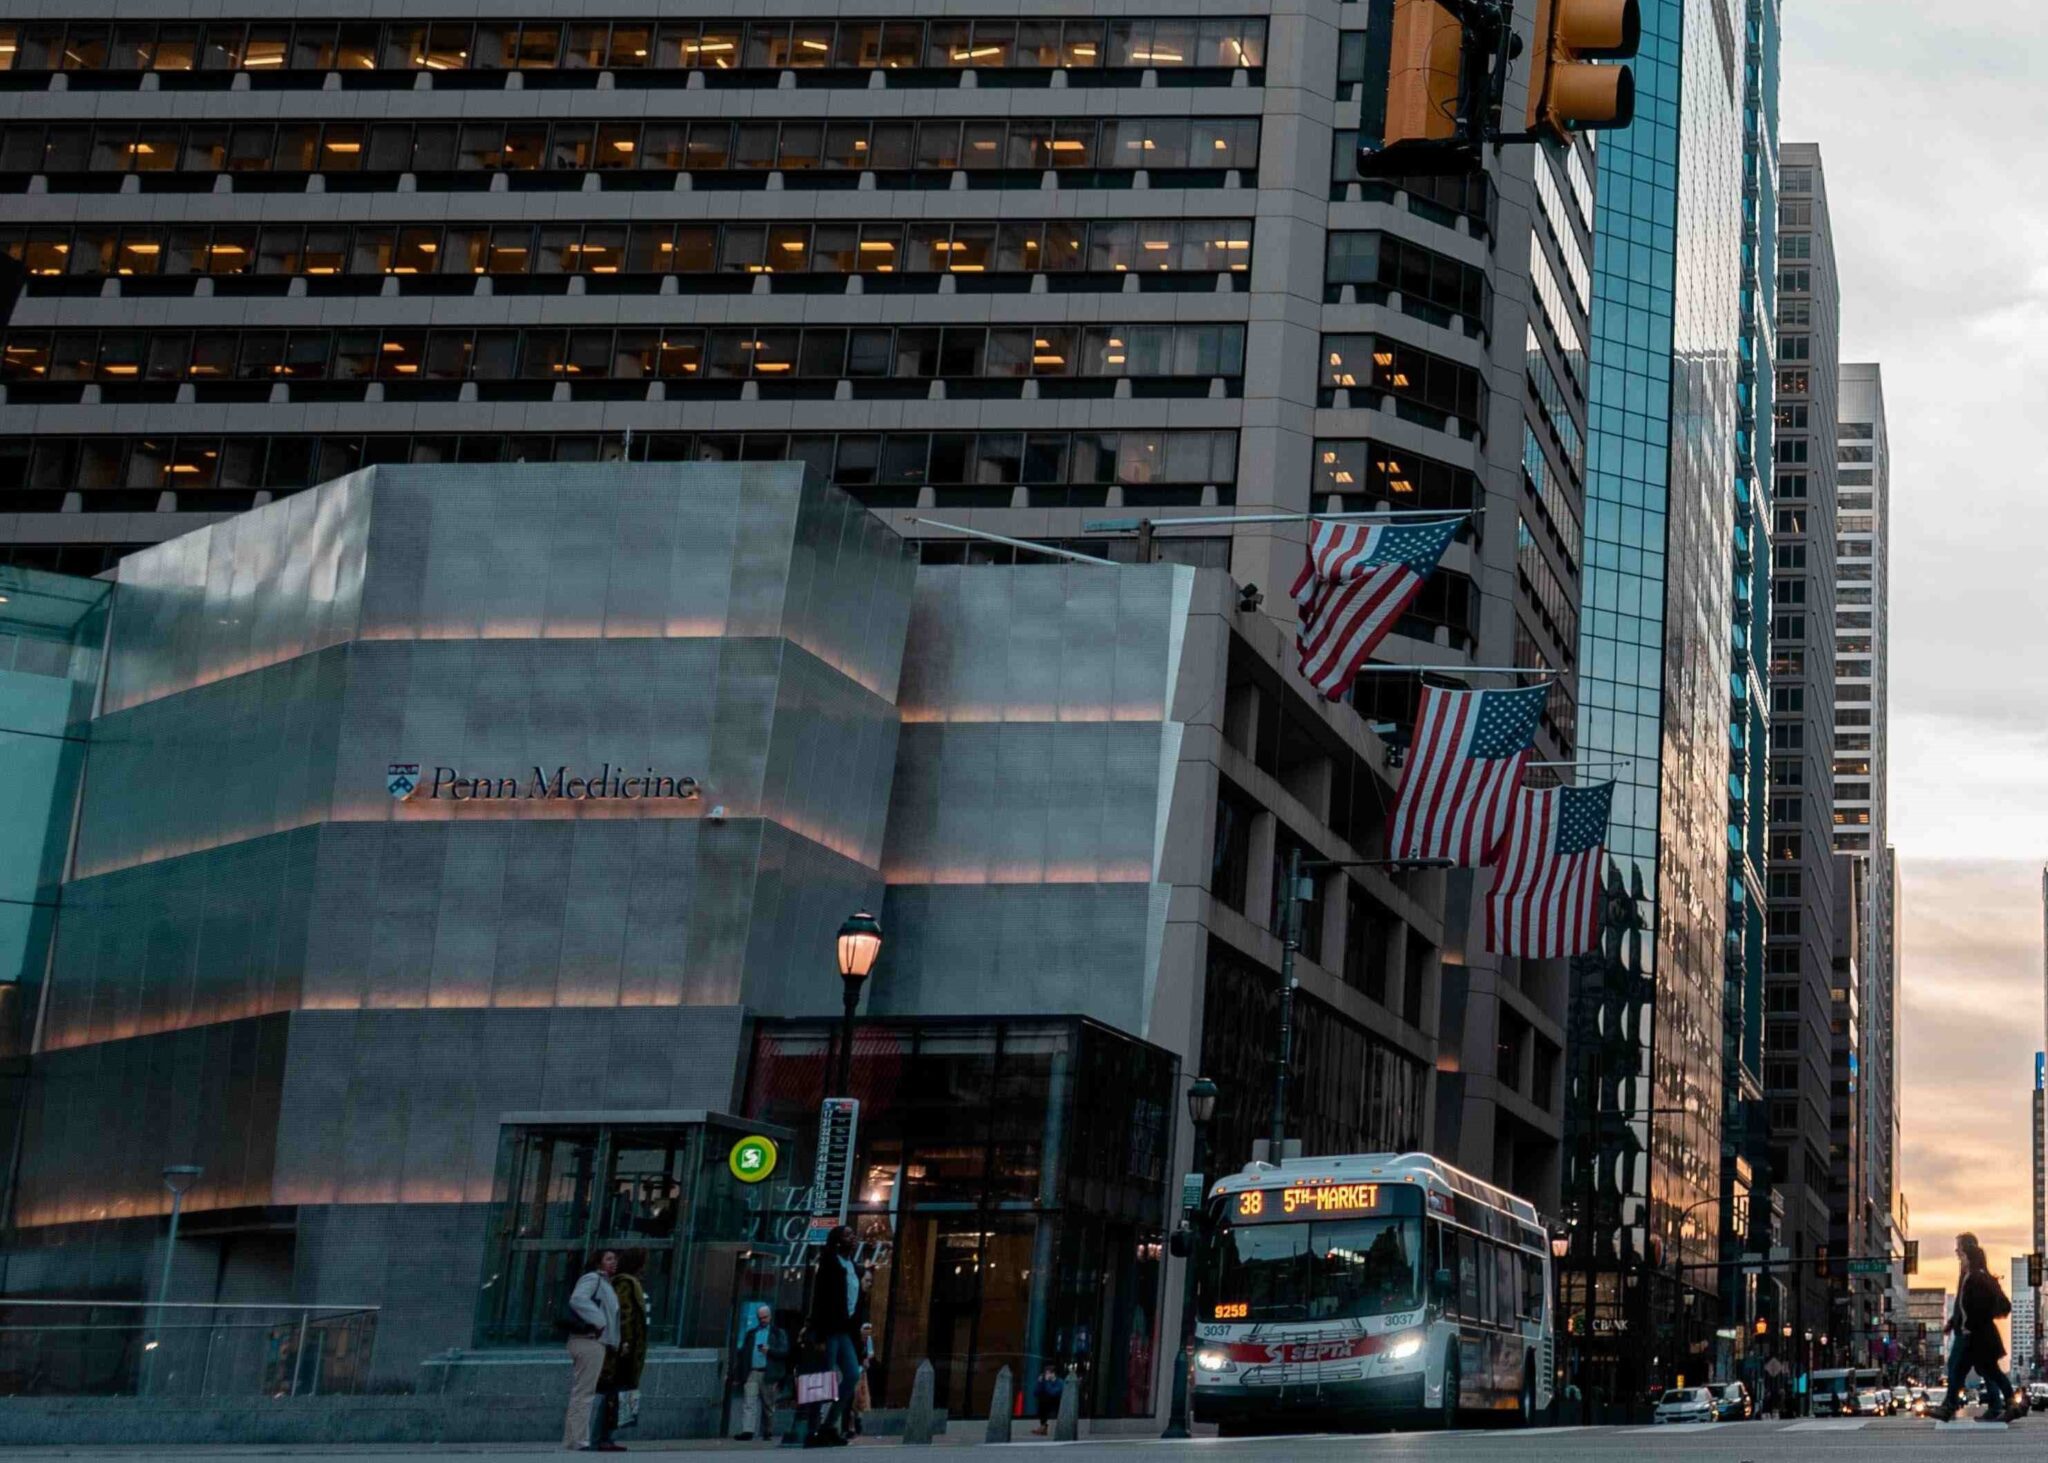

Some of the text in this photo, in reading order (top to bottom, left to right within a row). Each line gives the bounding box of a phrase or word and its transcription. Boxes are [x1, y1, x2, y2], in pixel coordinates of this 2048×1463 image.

[431, 763, 699, 800] Penn Medicine
[1239, 1185, 1379, 1215] 38 5TH-MARKET
[1214, 1304, 1248, 1319] 9258
[1384, 1314, 1415, 1327] 3037
[1204, 1325, 1232, 1337] 3037
[1290, 1343, 1353, 1360] SEPTA
